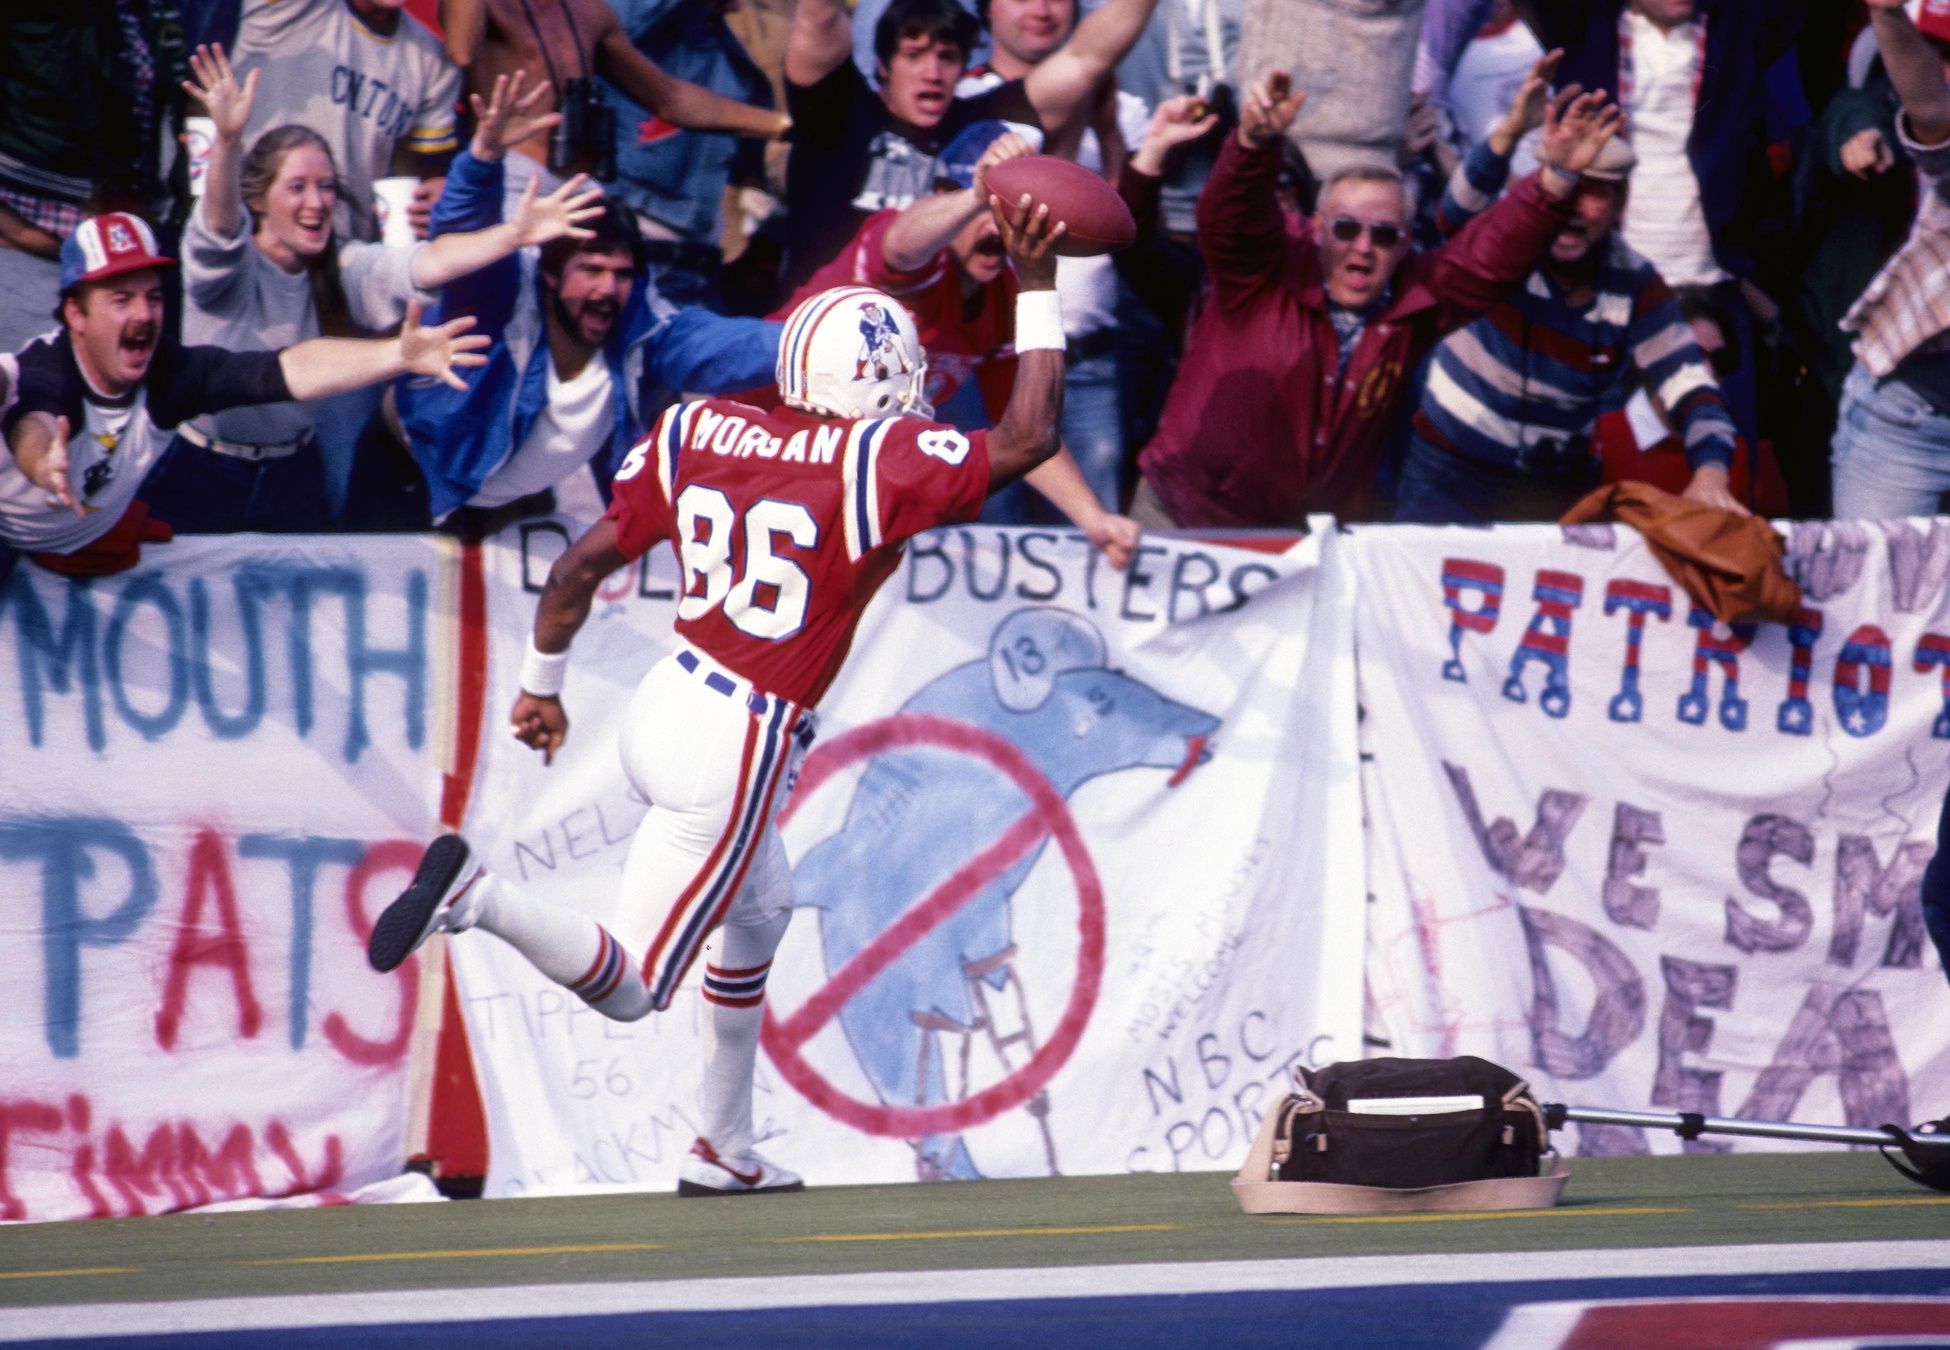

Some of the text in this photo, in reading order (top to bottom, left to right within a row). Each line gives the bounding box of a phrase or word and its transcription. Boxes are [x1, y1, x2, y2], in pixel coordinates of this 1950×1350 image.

[691, 406, 842, 464] MORGAN
[675, 482, 820, 640] 86
[906, 530, 1282, 622] BUSTERS
[5, 559, 427, 763] MOUTH
[1001, 636, 1047, 682] 13
[514, 800, 636, 881] NEL
[1443, 758, 1667, 932] WE
[570, 1057, 633, 1100] 56
[1143, 1010, 1279, 1117] NBC
